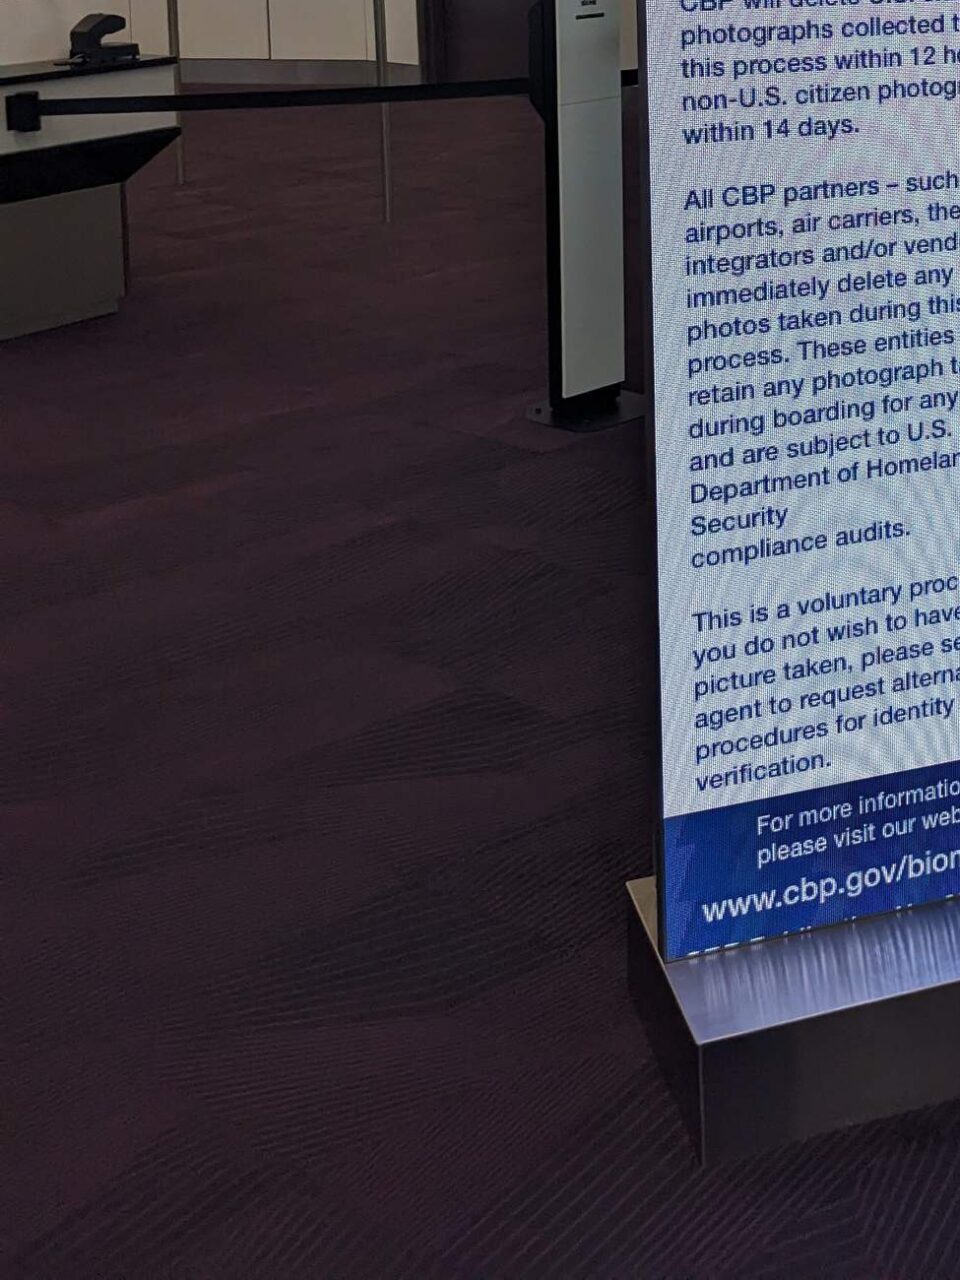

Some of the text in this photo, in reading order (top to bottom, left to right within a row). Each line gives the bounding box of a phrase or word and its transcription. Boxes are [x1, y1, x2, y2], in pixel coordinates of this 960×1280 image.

[680, 19, 833, 50] photographs
[840, 13, 945, 38] collected
[681, 85, 787, 111] non-U.S.
[794, 83, 870, 105] citizen
[682, 116, 859, 144] within 14 days.
[683, 188, 713, 210] All
[721, 183, 775, 207] CBP
[783, 179, 879, 207] partners
[906, 170, 959, 192] such
[684, 217, 783, 245] airports,
[791, 212, 821, 234] air
[827, 208, 919, 230] carriers,
[684, 248, 814, 277] integrators
[822, 238, 897, 263] and/or
[686, 267, 953, 308] immediately delete any
[686, 317, 771, 346] photos
[777, 310, 841, 332] taken
[849, 300, 921, 323] during
[687, 347, 789, 379] process.
[796, 338, 866, 360] These
[873, 327, 955, 352] entities
[687, 381, 755, 406] retain
[763, 377, 804, 399] any
[812, 357, 943, 396] photograph
[687, 414, 765, 439] during
[772, 400, 875, 428] boarding
[881, 394, 913, 414] for
[918, 390, 959, 411] any
[690, 466, 830, 504] Department
[836, 461, 858, 483] of
[690, 506, 788, 536] Security
[690, 520, 910, 568] compliance audits.
[692, 608, 742, 632] This
[749, 604, 768, 623] is
[775, 602, 790, 619] a
[797, 584, 902, 615] voluntary
[693, 668, 776, 702] picture
[782, 656, 852, 680] taken,
[860, 640, 934, 672] please
[694, 699, 761, 731] agent
[767, 696, 792, 715] to
[799, 677, 884, 709] request
[695, 697, 954, 765] procedures for identity
[695, 753, 830, 791] verification.
[756, 813, 793, 835] For
[798, 802, 852, 826] more
[756, 836, 827, 869] please
[833, 823, 875, 848] visit
[881, 817, 916, 838] our
